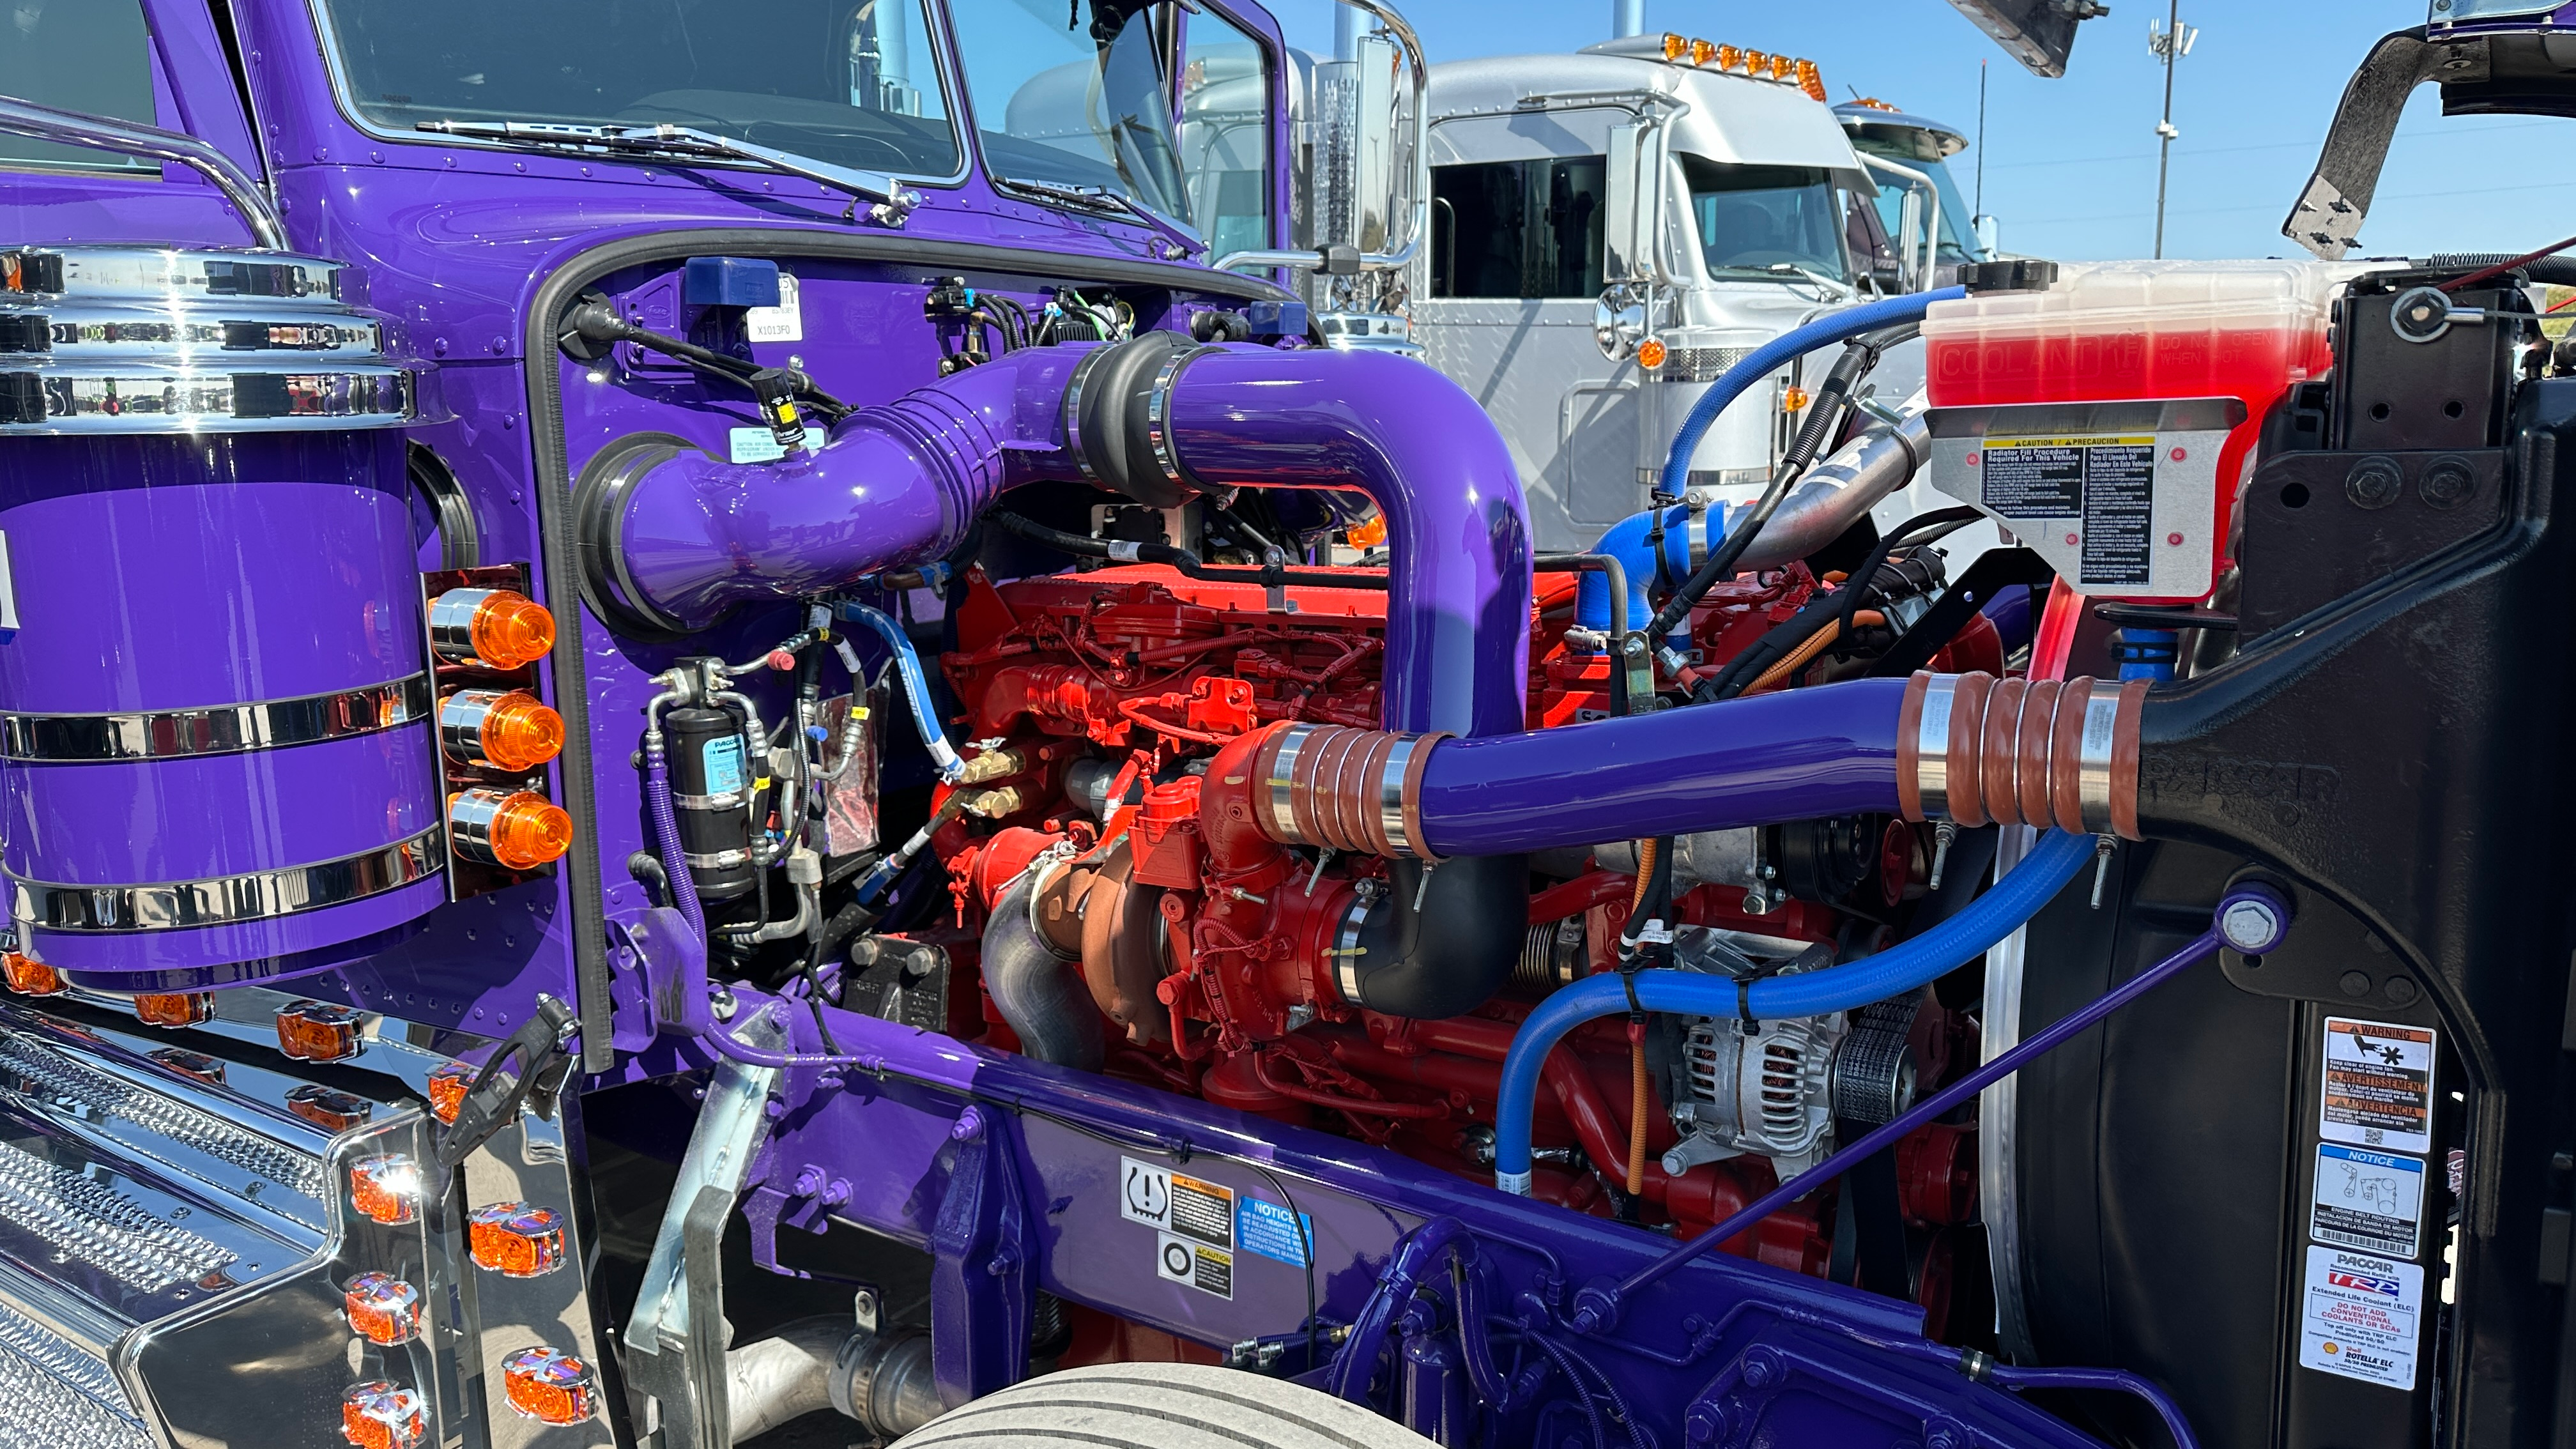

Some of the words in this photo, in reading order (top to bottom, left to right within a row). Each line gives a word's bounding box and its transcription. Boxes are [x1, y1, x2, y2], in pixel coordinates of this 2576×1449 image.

[1942, 342, 2094, 376] COOLANT
[2361, 1025, 2411, 1039] WARNING
[2342, 1073, 2425, 1091] AVERTISSEMENT
[2378, 1087, 2407, 1095] ventilateur
[2347, 1099, 2417, 1116] ADVERTENCIA
[2391, 1114, 2418, 1123] ventilador
[2348, 1151, 2395, 1167] NOTICE
[1189, 1180, 1219, 1195] WARNING
[1252, 1213, 1265, 1222] BAG
[1266, 1218, 1292, 1230] HEIGHTS
[2317, 1211, 2353, 1222] INSTALACION
[2363, 1219, 2382, 1228] BANDA
[2392, 1224, 2414, 1234] MOTOR
[2331, 1207, 2354, 1216] ENGINE
[2372, 1214, 2400, 1224] ROUTING
[1250, 1227, 1291, 1245] ACCORDANCE
[1252, 1220, 1290, 1237] READJUSTED
[2315, 1216, 2342, 1227] PARCOURS
[2393, 1231, 2414, 1240] MOTEUR
[1243, 1231, 1286, 1250] INSTRUCTIONS
[1244, 1238, 1280, 1255] OPERATORS
[1202, 1250, 1230, 1264] CAUTION
[2337, 1254, 2394, 1273] PACCAR
[2330, 1263, 2370, 1275] Recommended
[2334, 1273, 2399, 1296] TRP
[2312, 1286, 2345, 1298] Extended
[2347, 1292, 2361, 1301] Life
[2363, 1296, 2391, 1307] Coolant
[2393, 1303, 2414, 1312] (ELC)
[2331, 1307, 2392, 1324] CONVENTIONAL
[2351, 1304, 2367, 1313] NOT
[2369, 1308, 2386, 1317] ADD
[2321, 1311, 2363, 1325] COOLANTS
[2365, 1319, 2377, 1328] OR
[2379, 1322, 2401, 1333] SCAs
[2324, 1322, 2334, 1330] Top
[2335, 1330, 2365, 1340] Prediluted
[2365, 1336, 2385, 1344] 50/50
[2345, 1353, 2377, 1365] ROTELLA
[2380, 1359, 2394, 1368] ELC
[2360, 1361, 2388, 1372] PREDILUTED
